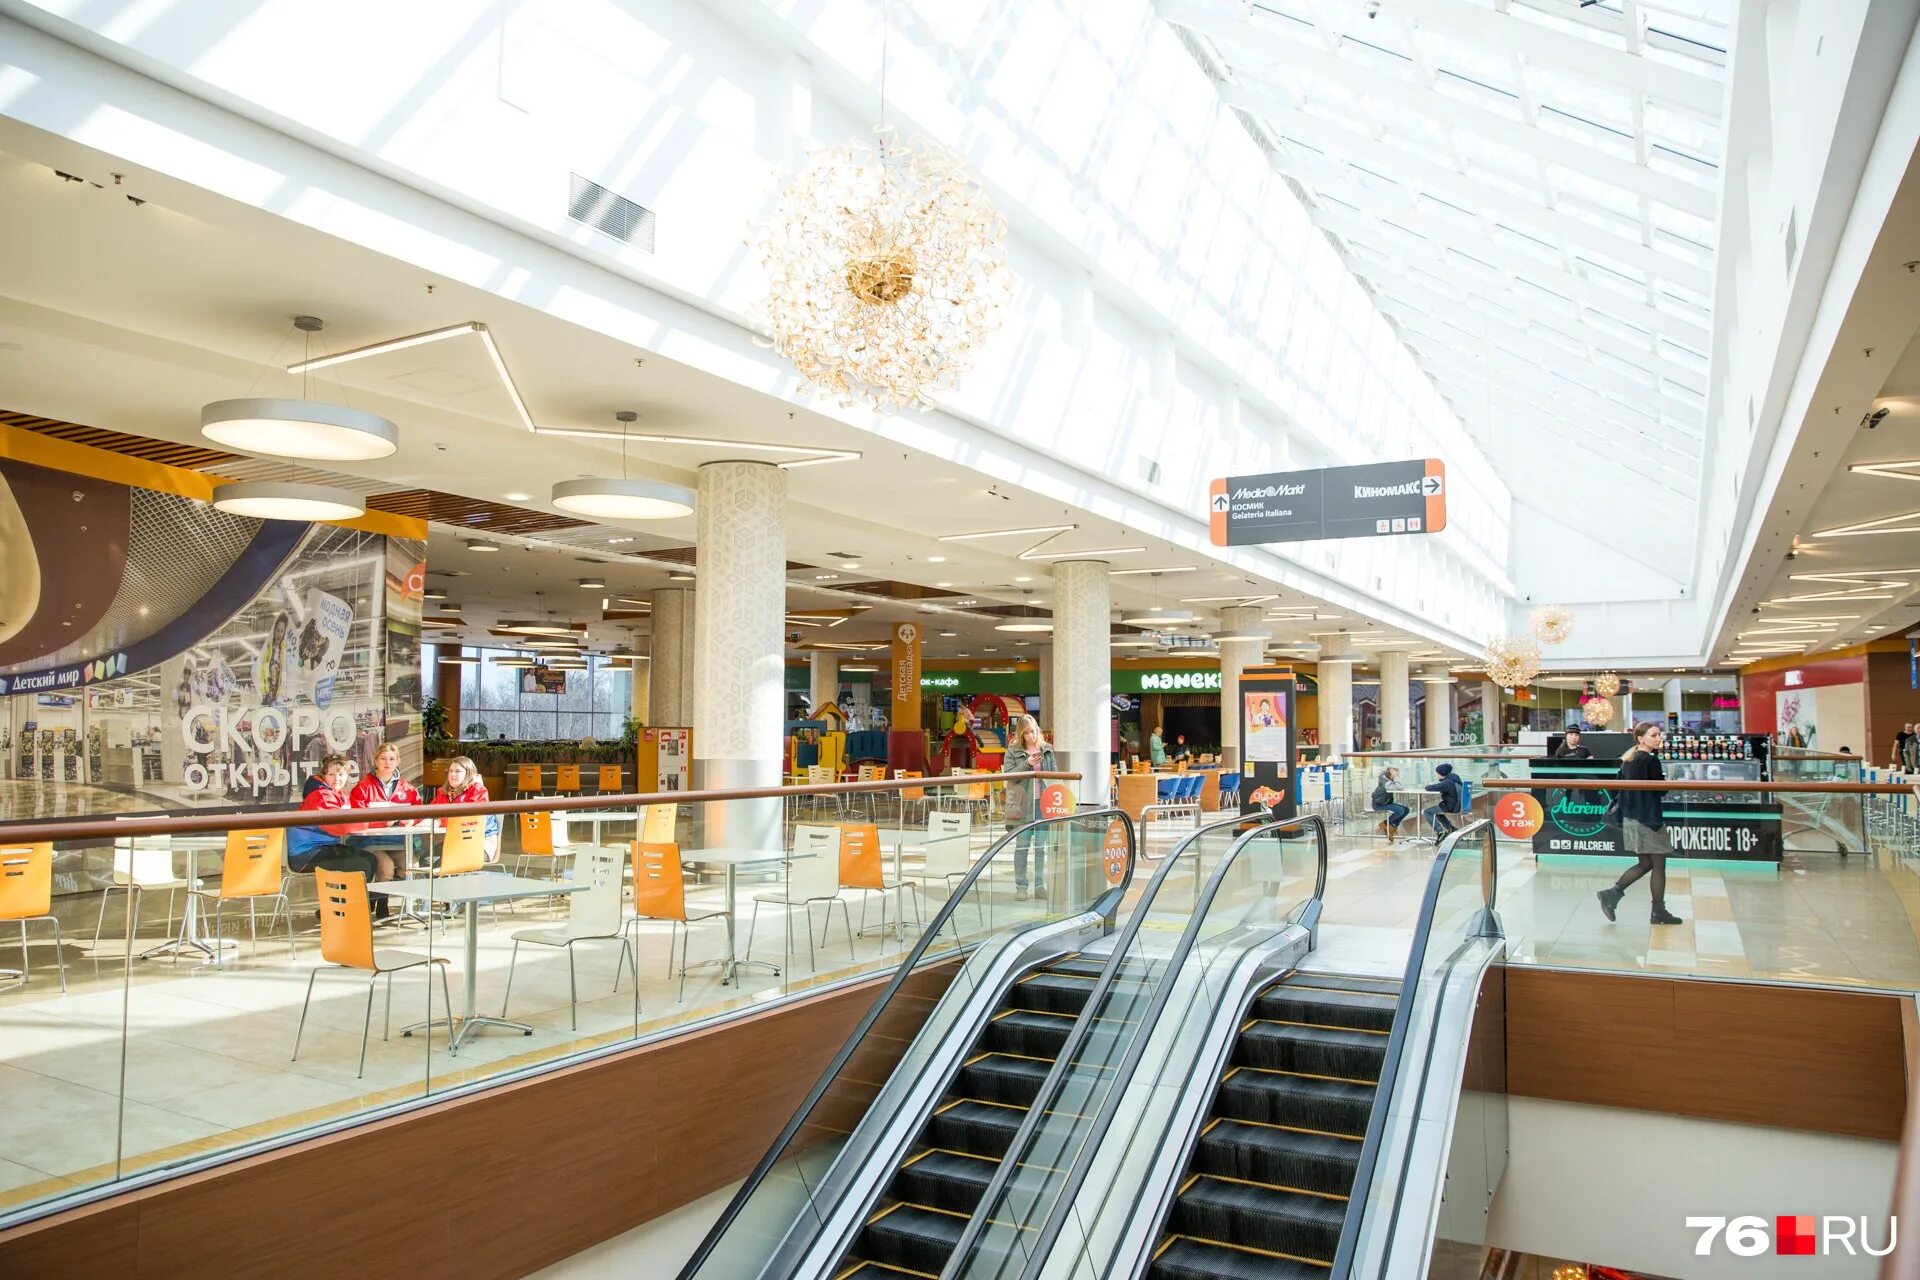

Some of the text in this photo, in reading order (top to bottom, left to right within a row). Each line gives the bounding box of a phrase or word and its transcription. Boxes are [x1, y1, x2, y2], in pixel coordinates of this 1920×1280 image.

[1354, 480, 1421, 499] КИНОМАКС
[1232, 502, 1264, 511] КОСМИК
[1232, 509, 1293, 520] Gelateria Italiana
[320, 598, 351, 624] модная
[322, 616, 346, 640] осень
[12, 669, 79, 690] Детский мир
[897, 660, 908, 702] Детская
[920, 677, 959, 687] ок-кафе
[182, 705, 357, 753] СКОРО
[184, 759, 360, 797] открыте
[1052, 791, 1063, 806] 3
[1046, 806, 1069, 814] этаж
[1511, 801, 1525, 818] 3
[1503, 819, 1535, 828] этаж
[1573, 840, 1615, 851] #ALCREME
[1666, 826, 1758, 852] ОРОЖЕНОЕ 18+
